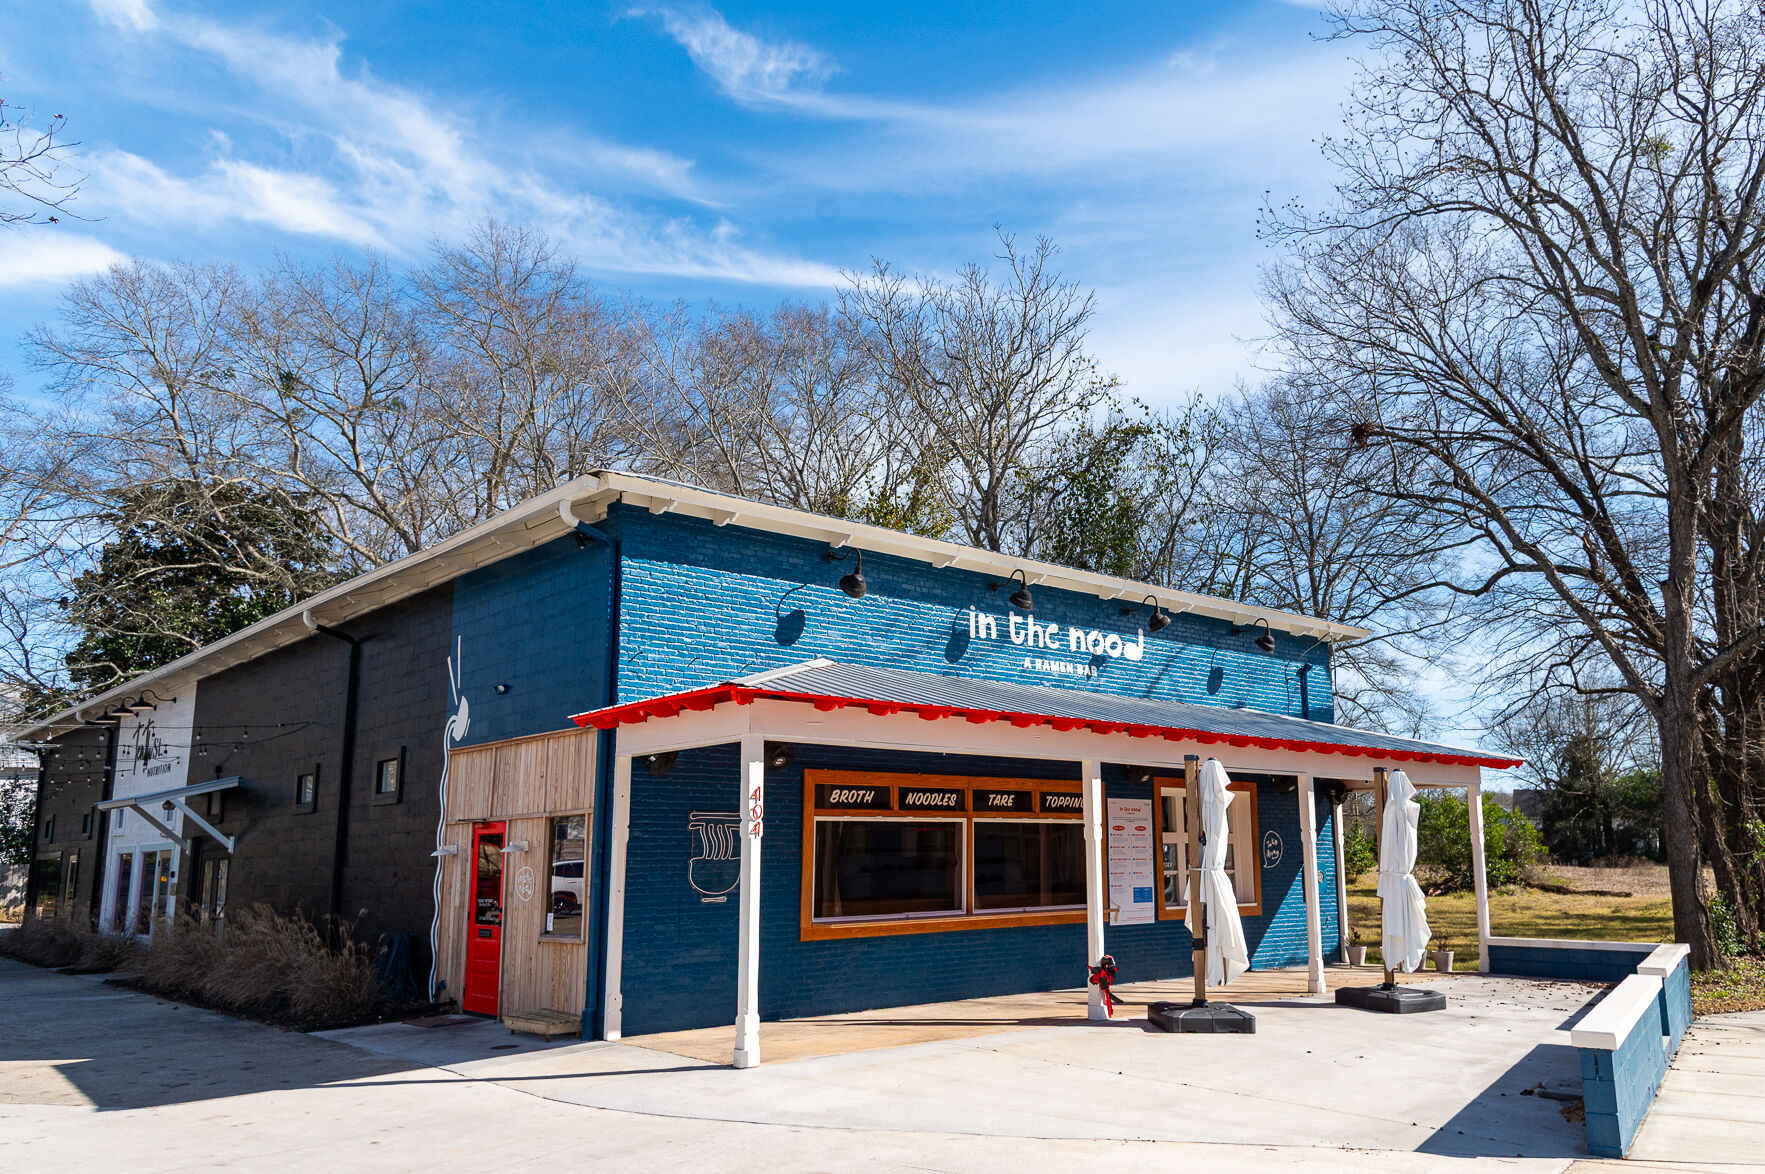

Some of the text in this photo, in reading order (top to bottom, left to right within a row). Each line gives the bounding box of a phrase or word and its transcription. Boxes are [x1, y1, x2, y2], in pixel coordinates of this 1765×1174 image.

[969, 605, 1144, 661] in the nood
[1023, 658, 1098, 678] A RAMEN BAR
[147, 763, 172, 777] NUTRITION
[829, 789, 875, 804] BROTH
[905, 792, 956, 807] NOODLES
[987, 793, 1015, 807] TARE
[749, 786, 764, 838] 404
